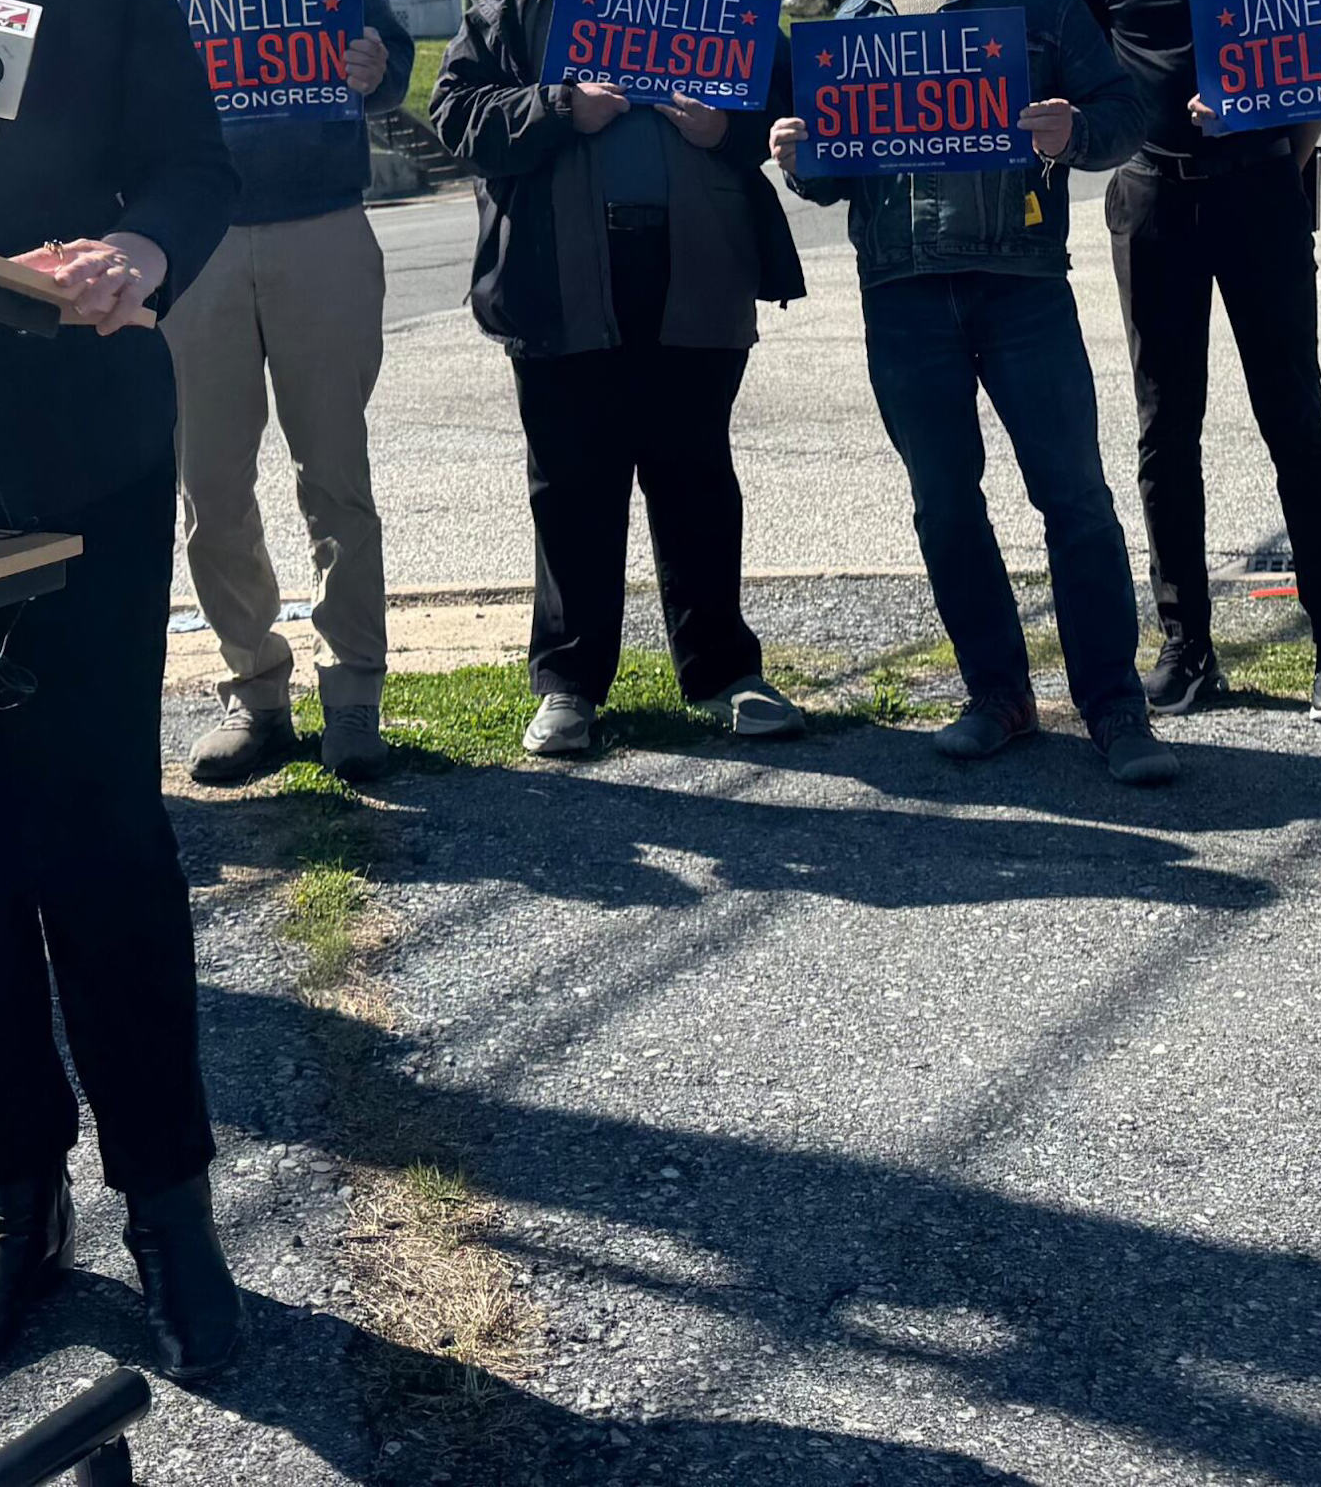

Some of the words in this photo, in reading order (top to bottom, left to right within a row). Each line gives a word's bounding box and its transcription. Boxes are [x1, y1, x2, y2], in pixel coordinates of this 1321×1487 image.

[194, 29, 347, 90] ELSON
[568, 19, 755, 79] STELSON
[836, 27, 982, 80] JANELLE
[214, 86, 348, 111] CONGRESS
[562, 66, 612, 85] FOR
[619, 74, 749, 96] CONGRESS
[815, 76, 1009, 137] STELSON
[1222, 94, 1271, 116] FOR
[816, 141, 864, 159] FOR
[872, 134, 1011, 157] CONGRESS
